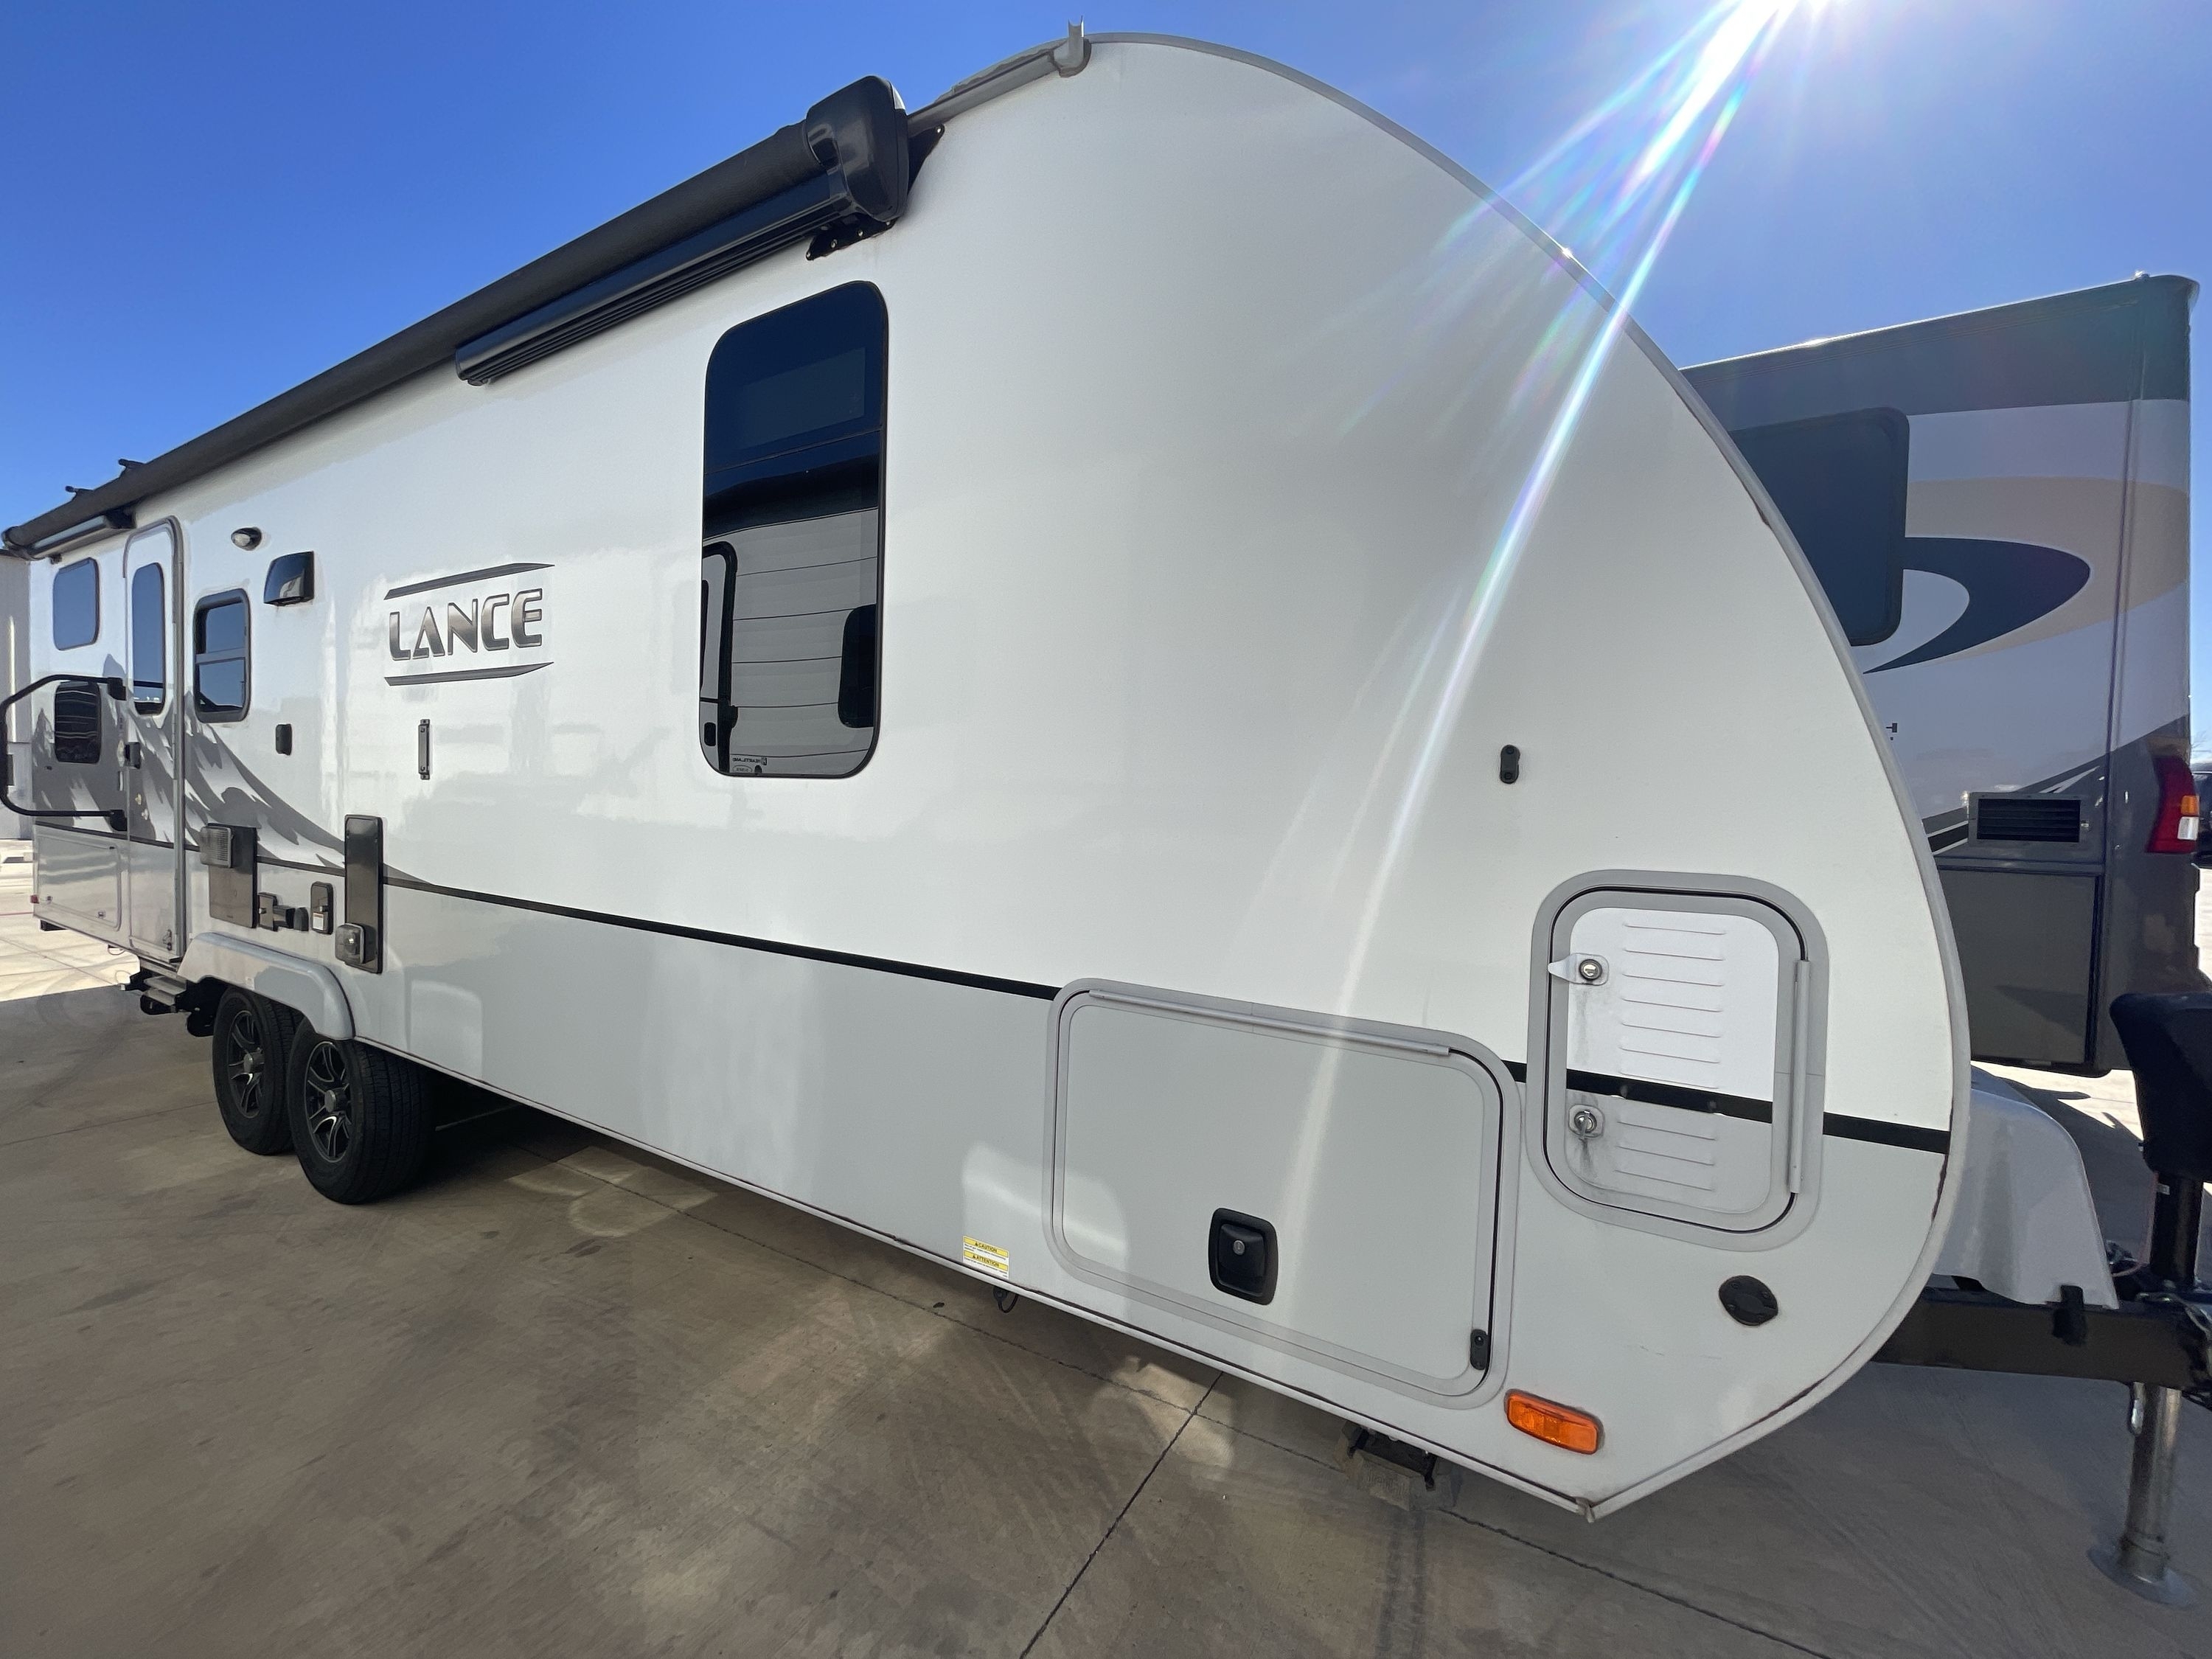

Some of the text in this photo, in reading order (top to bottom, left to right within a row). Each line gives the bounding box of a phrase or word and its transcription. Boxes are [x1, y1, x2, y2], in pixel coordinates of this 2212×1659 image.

[389, 588, 543, 661] LANCE
[978, 1242, 998, 1253] CAUTION
[976, 1254, 1000, 1267] ATTENTION
